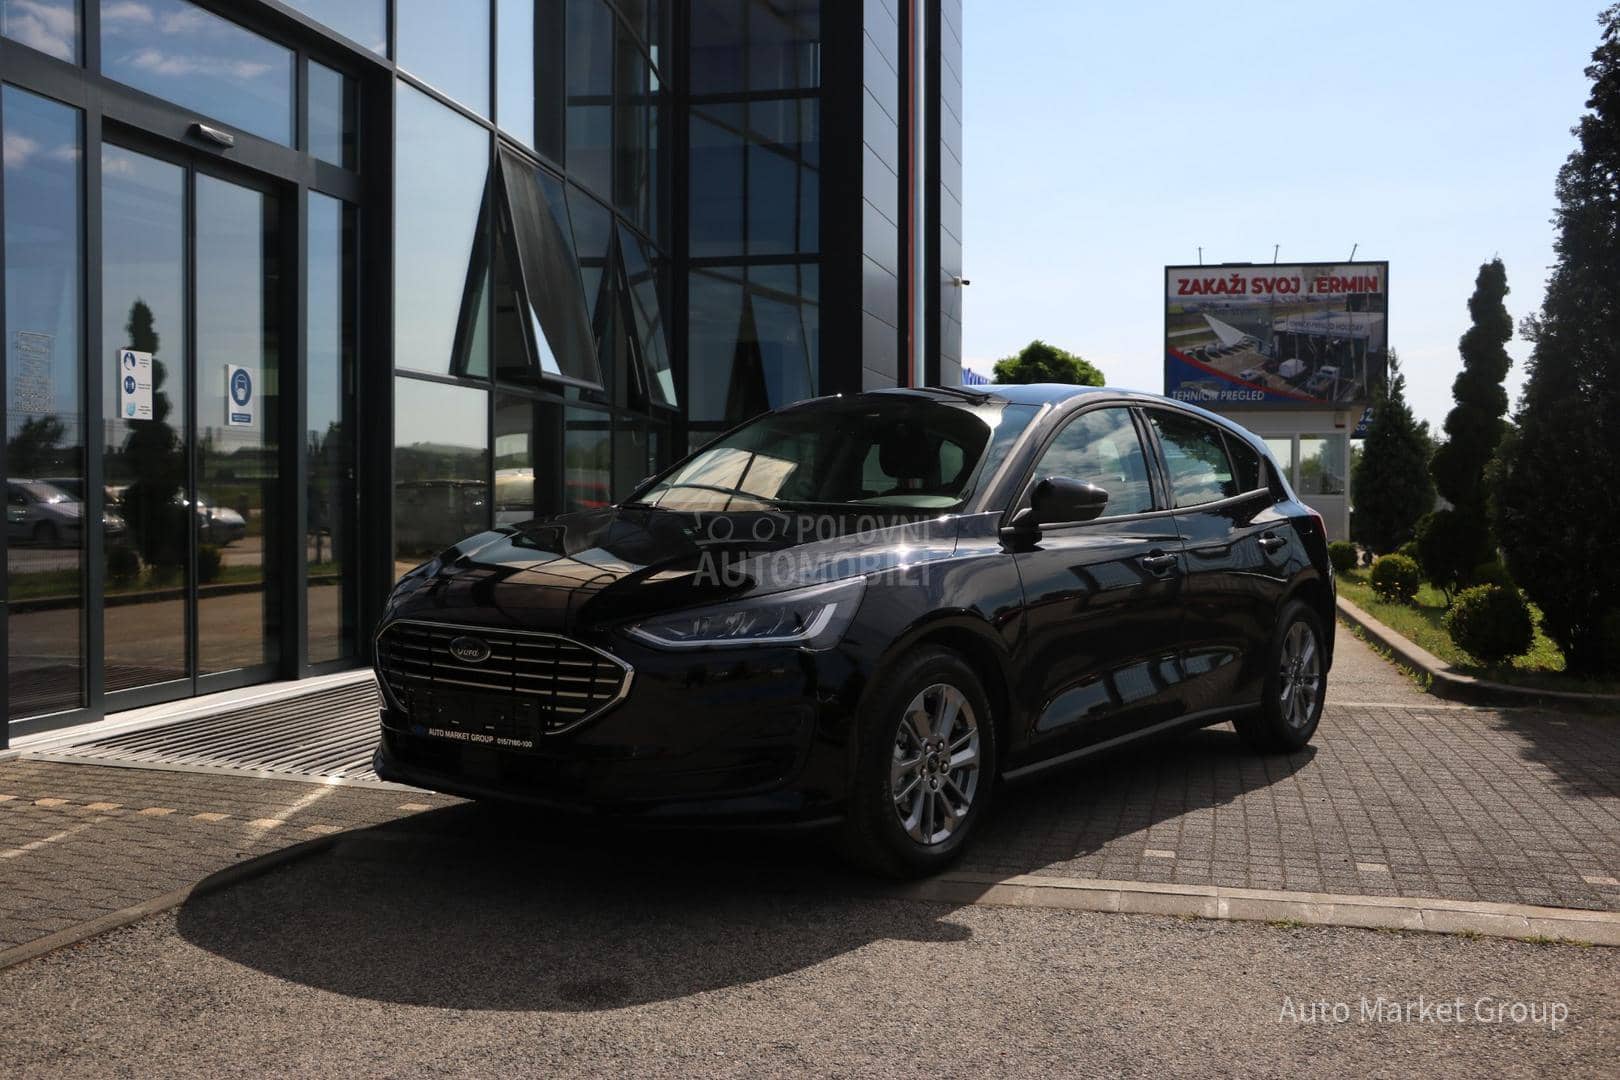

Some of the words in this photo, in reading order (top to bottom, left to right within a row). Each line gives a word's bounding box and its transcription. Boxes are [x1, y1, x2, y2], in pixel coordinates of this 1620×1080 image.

[1177, 274, 1246, 295] ZAKAŽI
[1251, 277, 1300, 294] SVOJ
[1221, 390, 1264, 400] PREGLED
[429, 727, 444, 737] AUTO
[445, 730, 470, 740] MARKET
[471, 733, 494, 743] GROUP
